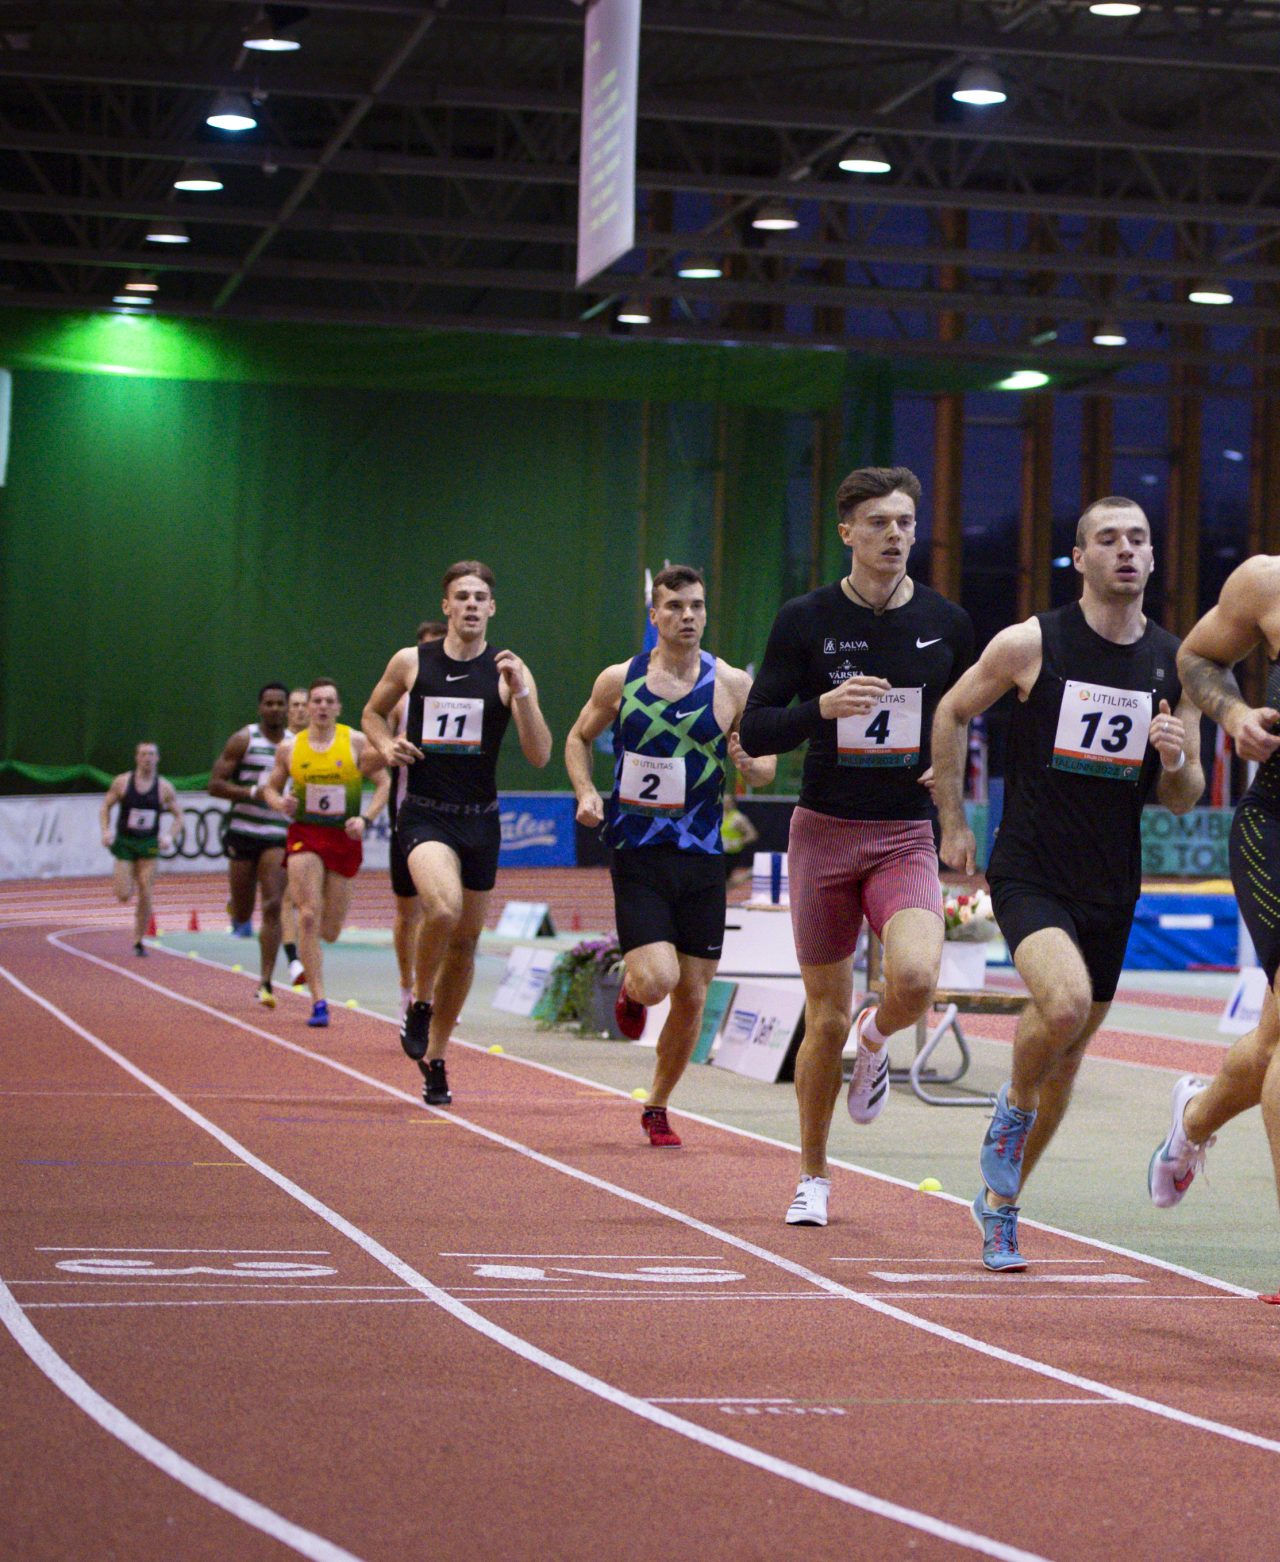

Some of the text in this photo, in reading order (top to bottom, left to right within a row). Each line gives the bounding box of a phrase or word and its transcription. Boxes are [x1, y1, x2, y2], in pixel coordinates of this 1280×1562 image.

[839, 641, 869, 649] SALVA
[1092, 692, 1138, 708] UTILITAS
[436, 713, 467, 738] 11
[864, 709, 890, 745] 4
[1080, 711, 1133, 753] 13
[640, 760, 673, 770] UTILITAS
[639, 773, 660, 800] 2
[319, 794, 330, 810] 6
